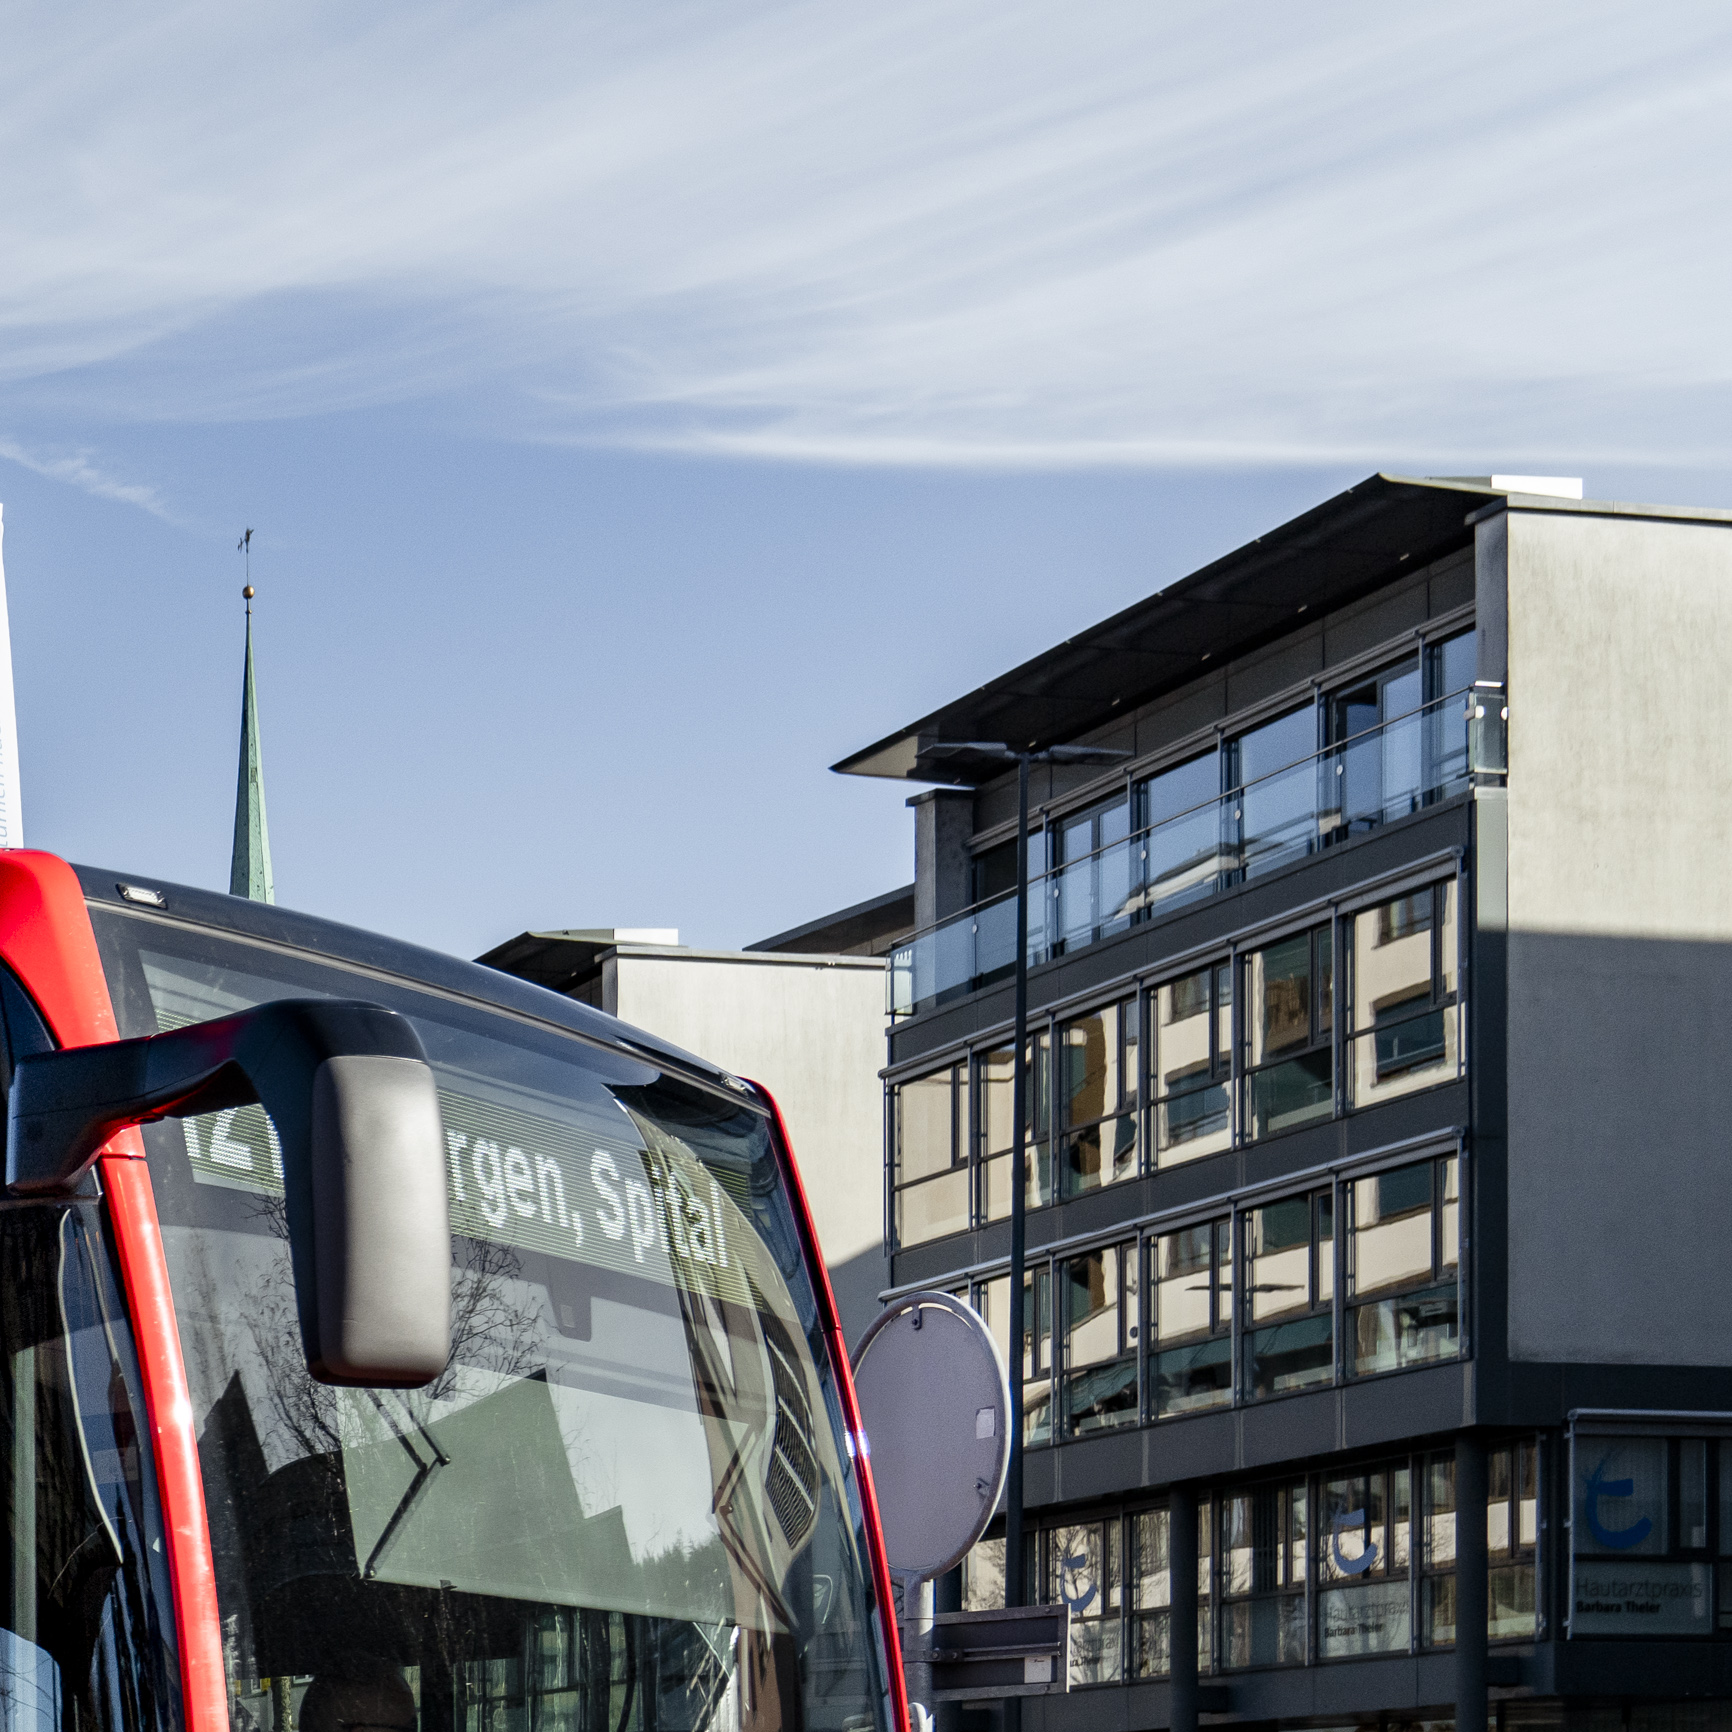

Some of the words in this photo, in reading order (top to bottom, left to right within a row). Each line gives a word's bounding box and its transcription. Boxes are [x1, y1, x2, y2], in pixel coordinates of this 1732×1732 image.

[446, 1128, 584, 1250] rgen,
[1576, 1601, 1622, 1613] Barbara
[1625, 1600, 1661, 1613] Theler
